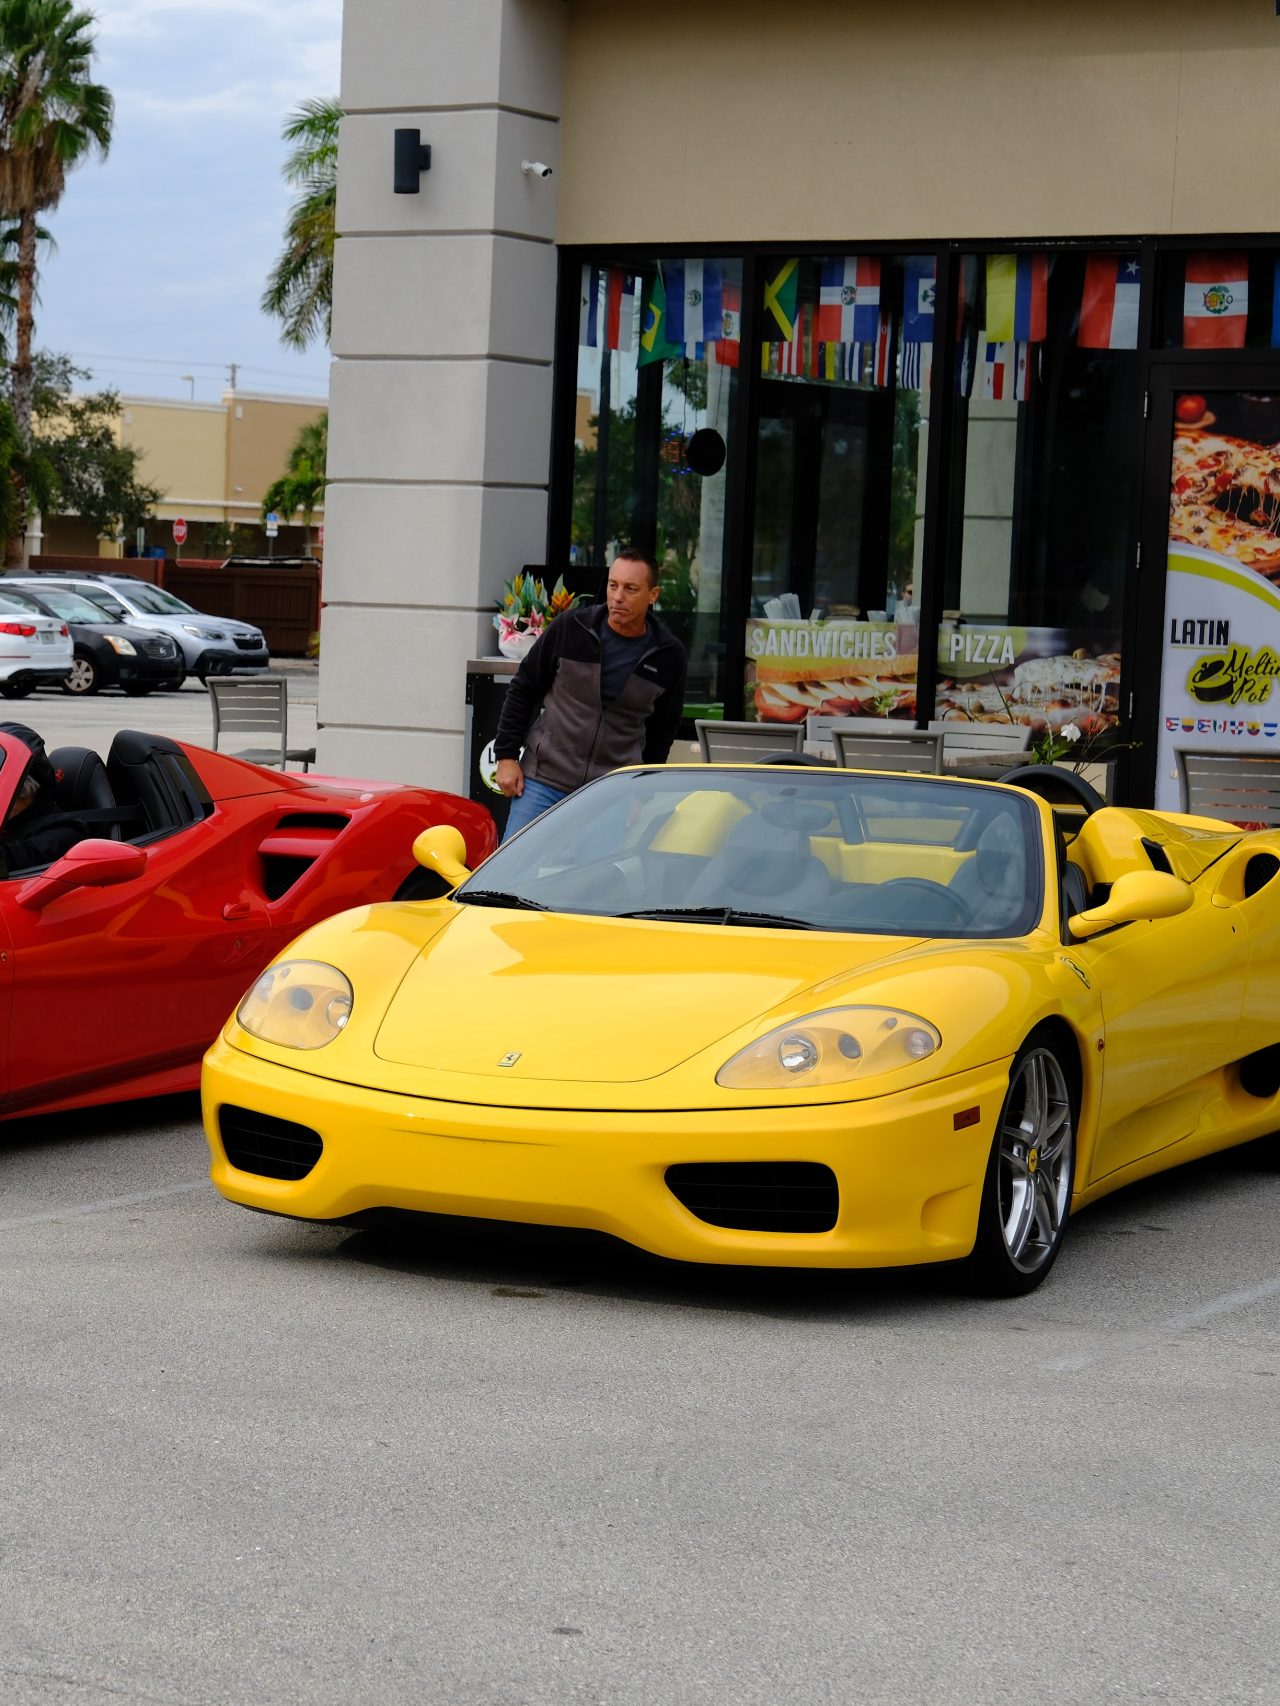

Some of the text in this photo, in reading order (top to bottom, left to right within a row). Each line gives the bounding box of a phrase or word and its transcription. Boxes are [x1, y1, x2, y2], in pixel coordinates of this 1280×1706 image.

[751, 627, 897, 660] SANDWICHES
[1170, 618, 1229, 645] LATIN
[949, 633, 1015, 665] PIZZA
[1230, 677, 1269, 705] Pot
